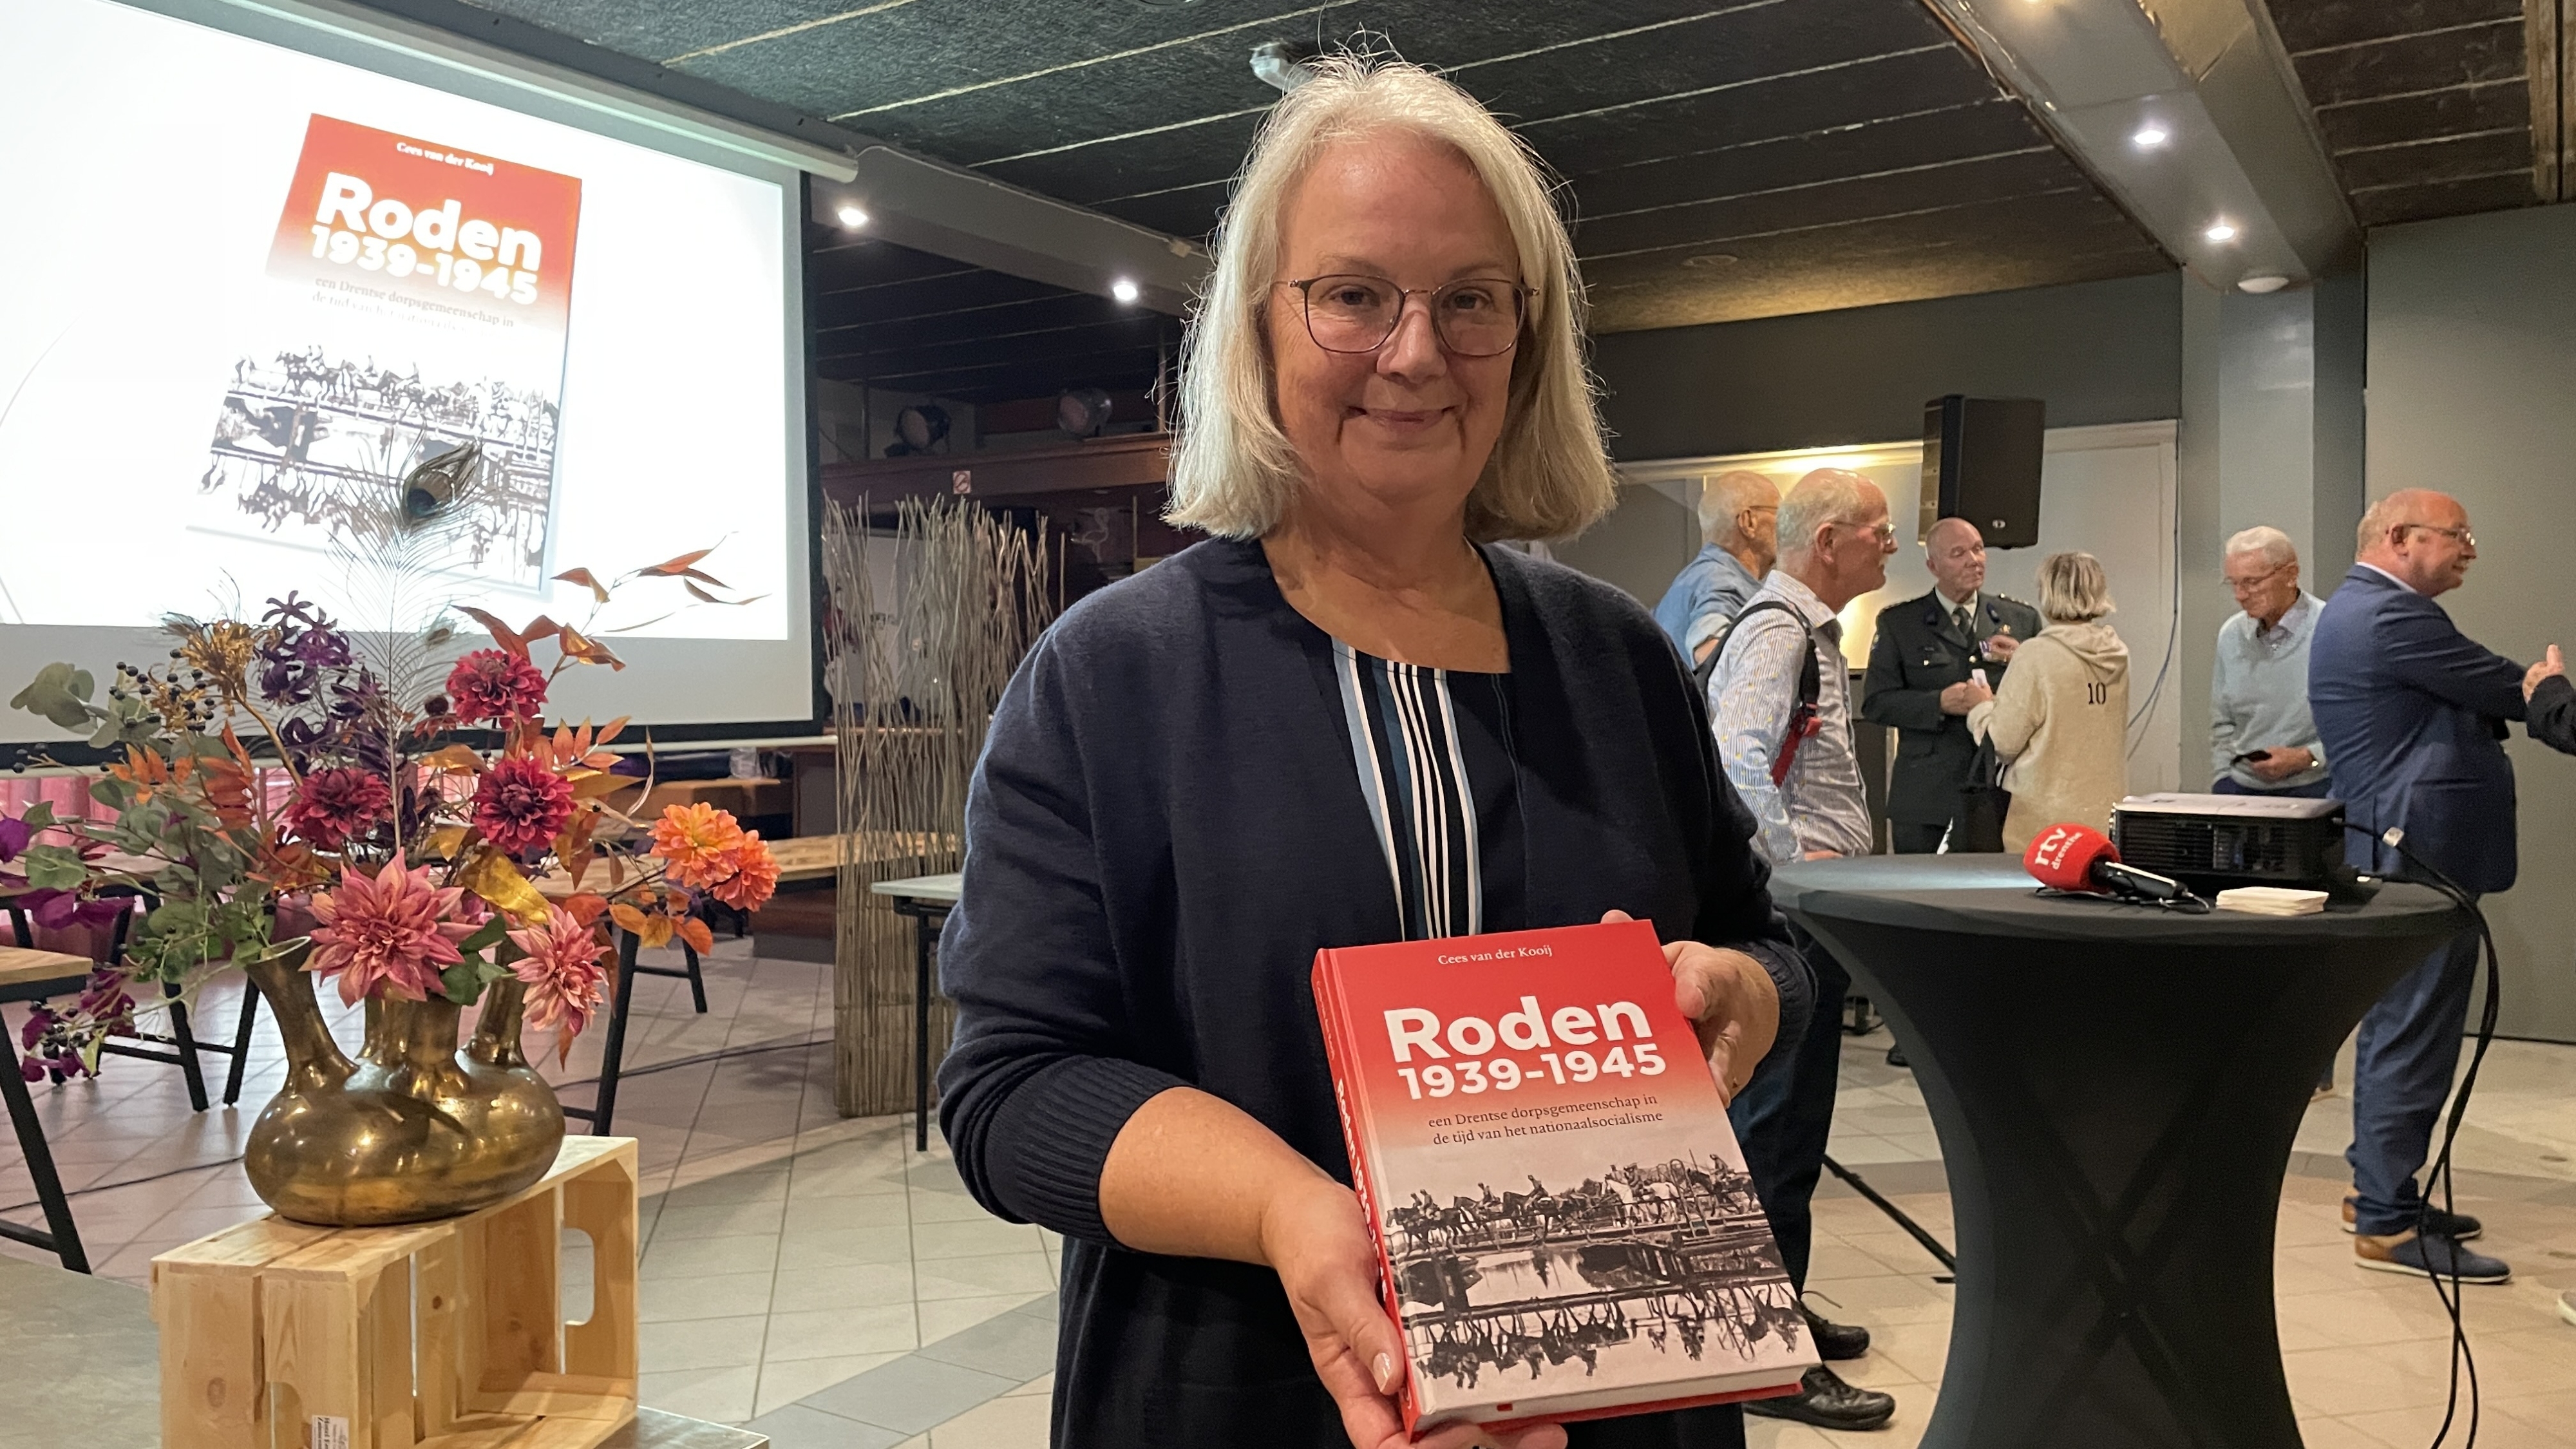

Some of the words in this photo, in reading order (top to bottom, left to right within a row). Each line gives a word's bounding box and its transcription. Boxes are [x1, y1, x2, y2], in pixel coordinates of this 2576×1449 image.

[316, 171, 542, 271] Roden
[311, 225, 538, 305] 1939-1945
[315, 277, 336, 290] een
[339, 281, 386, 299] Drentse
[388, 290, 500, 325] dorpsgemeenschap
[503, 316, 514, 328] in
[2088, 682, 2106, 705] 10
[2035, 828, 2067, 866] rtv
[2051, 832, 2083, 870] drenthe
[1438, 955, 1468, 965] Cees
[1470, 953, 1493, 961] van
[1495, 949, 1515, 960] der
[1518, 944, 1553, 957] Kooij
[1384, 995, 1653, 1063] Roden
[1397, 1043, 1667, 1100] 1939-1945
[1338, 1078, 1356, 1159] Roden
[1428, 1117, 1452, 1127] een
[1455, 1112, 1508, 1124] Drentse
[1511, 1097, 1641, 1119] dorpsgemeenschap
[1643, 1094, 1658, 1105] in
[1433, 1133, 1450, 1145] de
[1452, 1130, 1475, 1144] tijd
[1477, 1130, 1501, 1140] van
[1504, 1126, 1527, 1137] het
[1530, 1112, 1663, 1134] nationaalsocialisme
